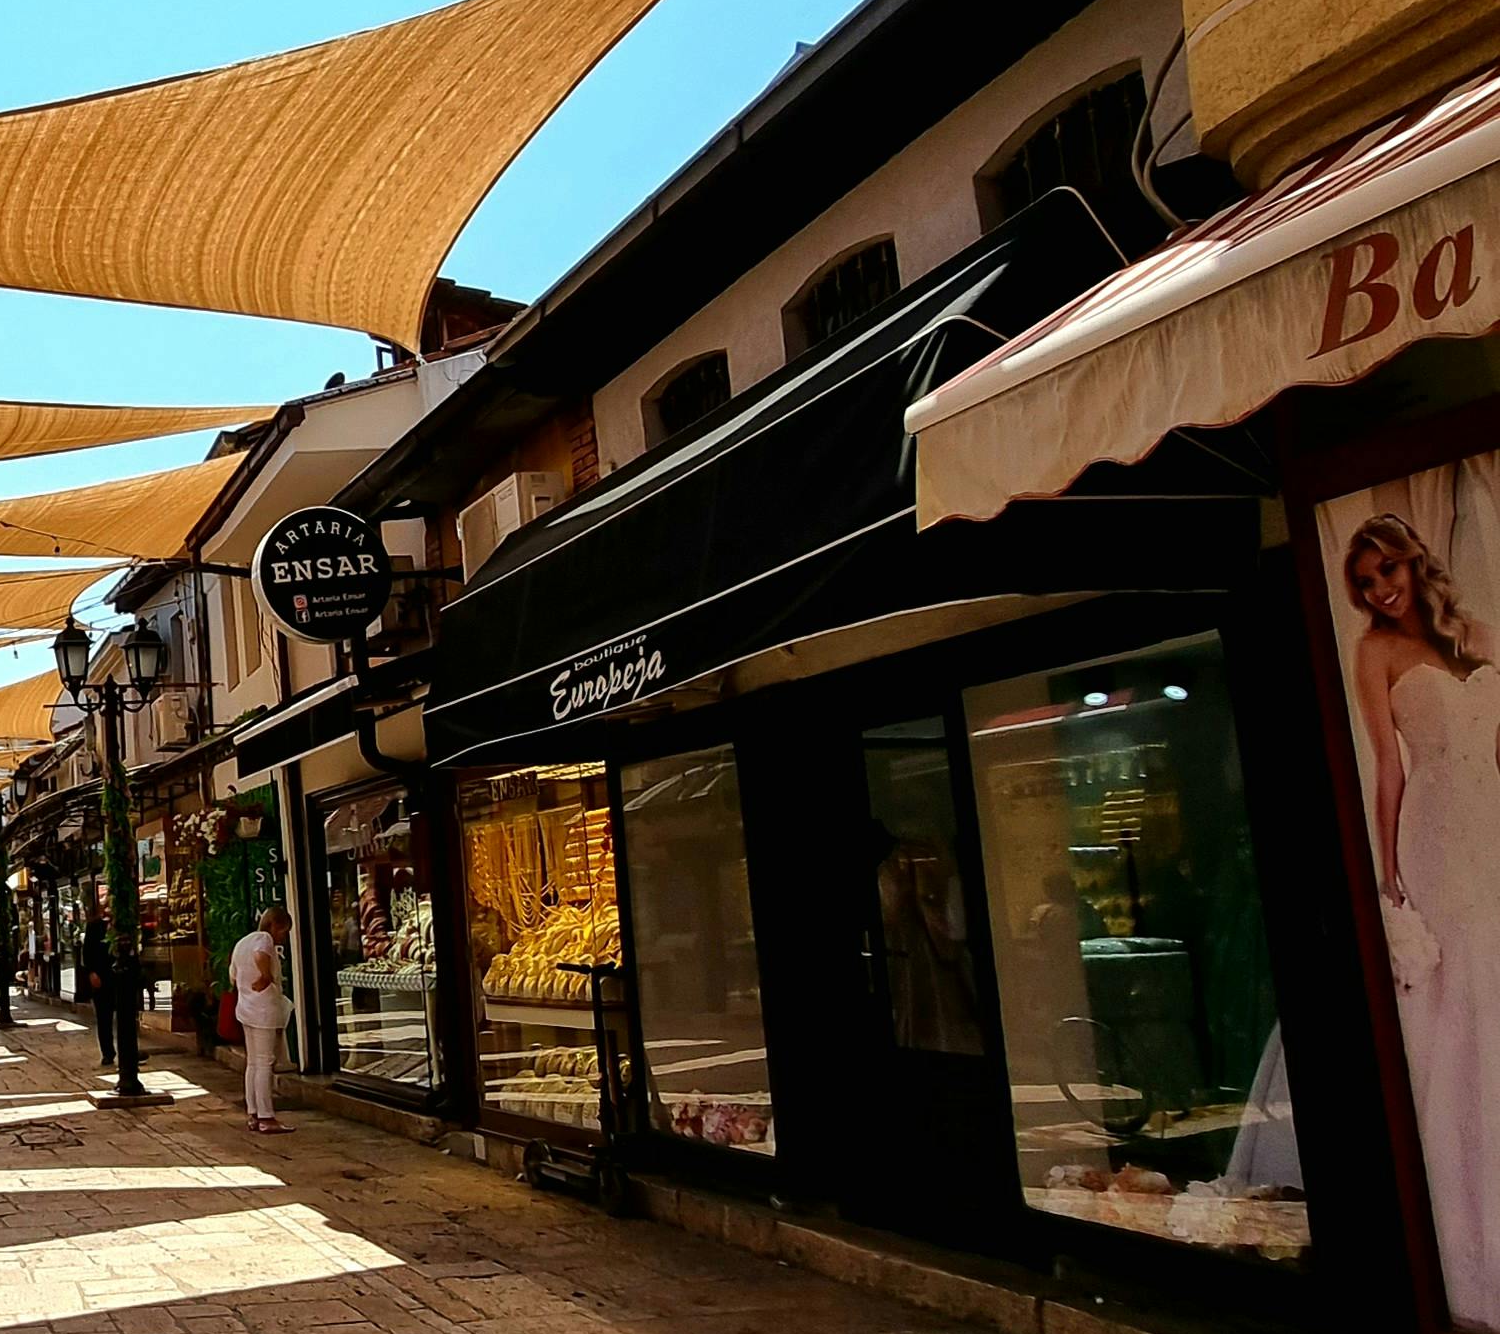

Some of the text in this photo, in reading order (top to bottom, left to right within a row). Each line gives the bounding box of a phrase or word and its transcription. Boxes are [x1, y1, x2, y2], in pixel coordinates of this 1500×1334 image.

[275, 520, 366, 555] ARTARIA
[271, 554, 380, 584] ENSAR
[312, 592, 367, 604] Artaria Ensar
[314, 607, 369, 619] Artaria Ensar
[573, 634, 648, 673] boutique
[549, 645, 667, 721] Europeja
